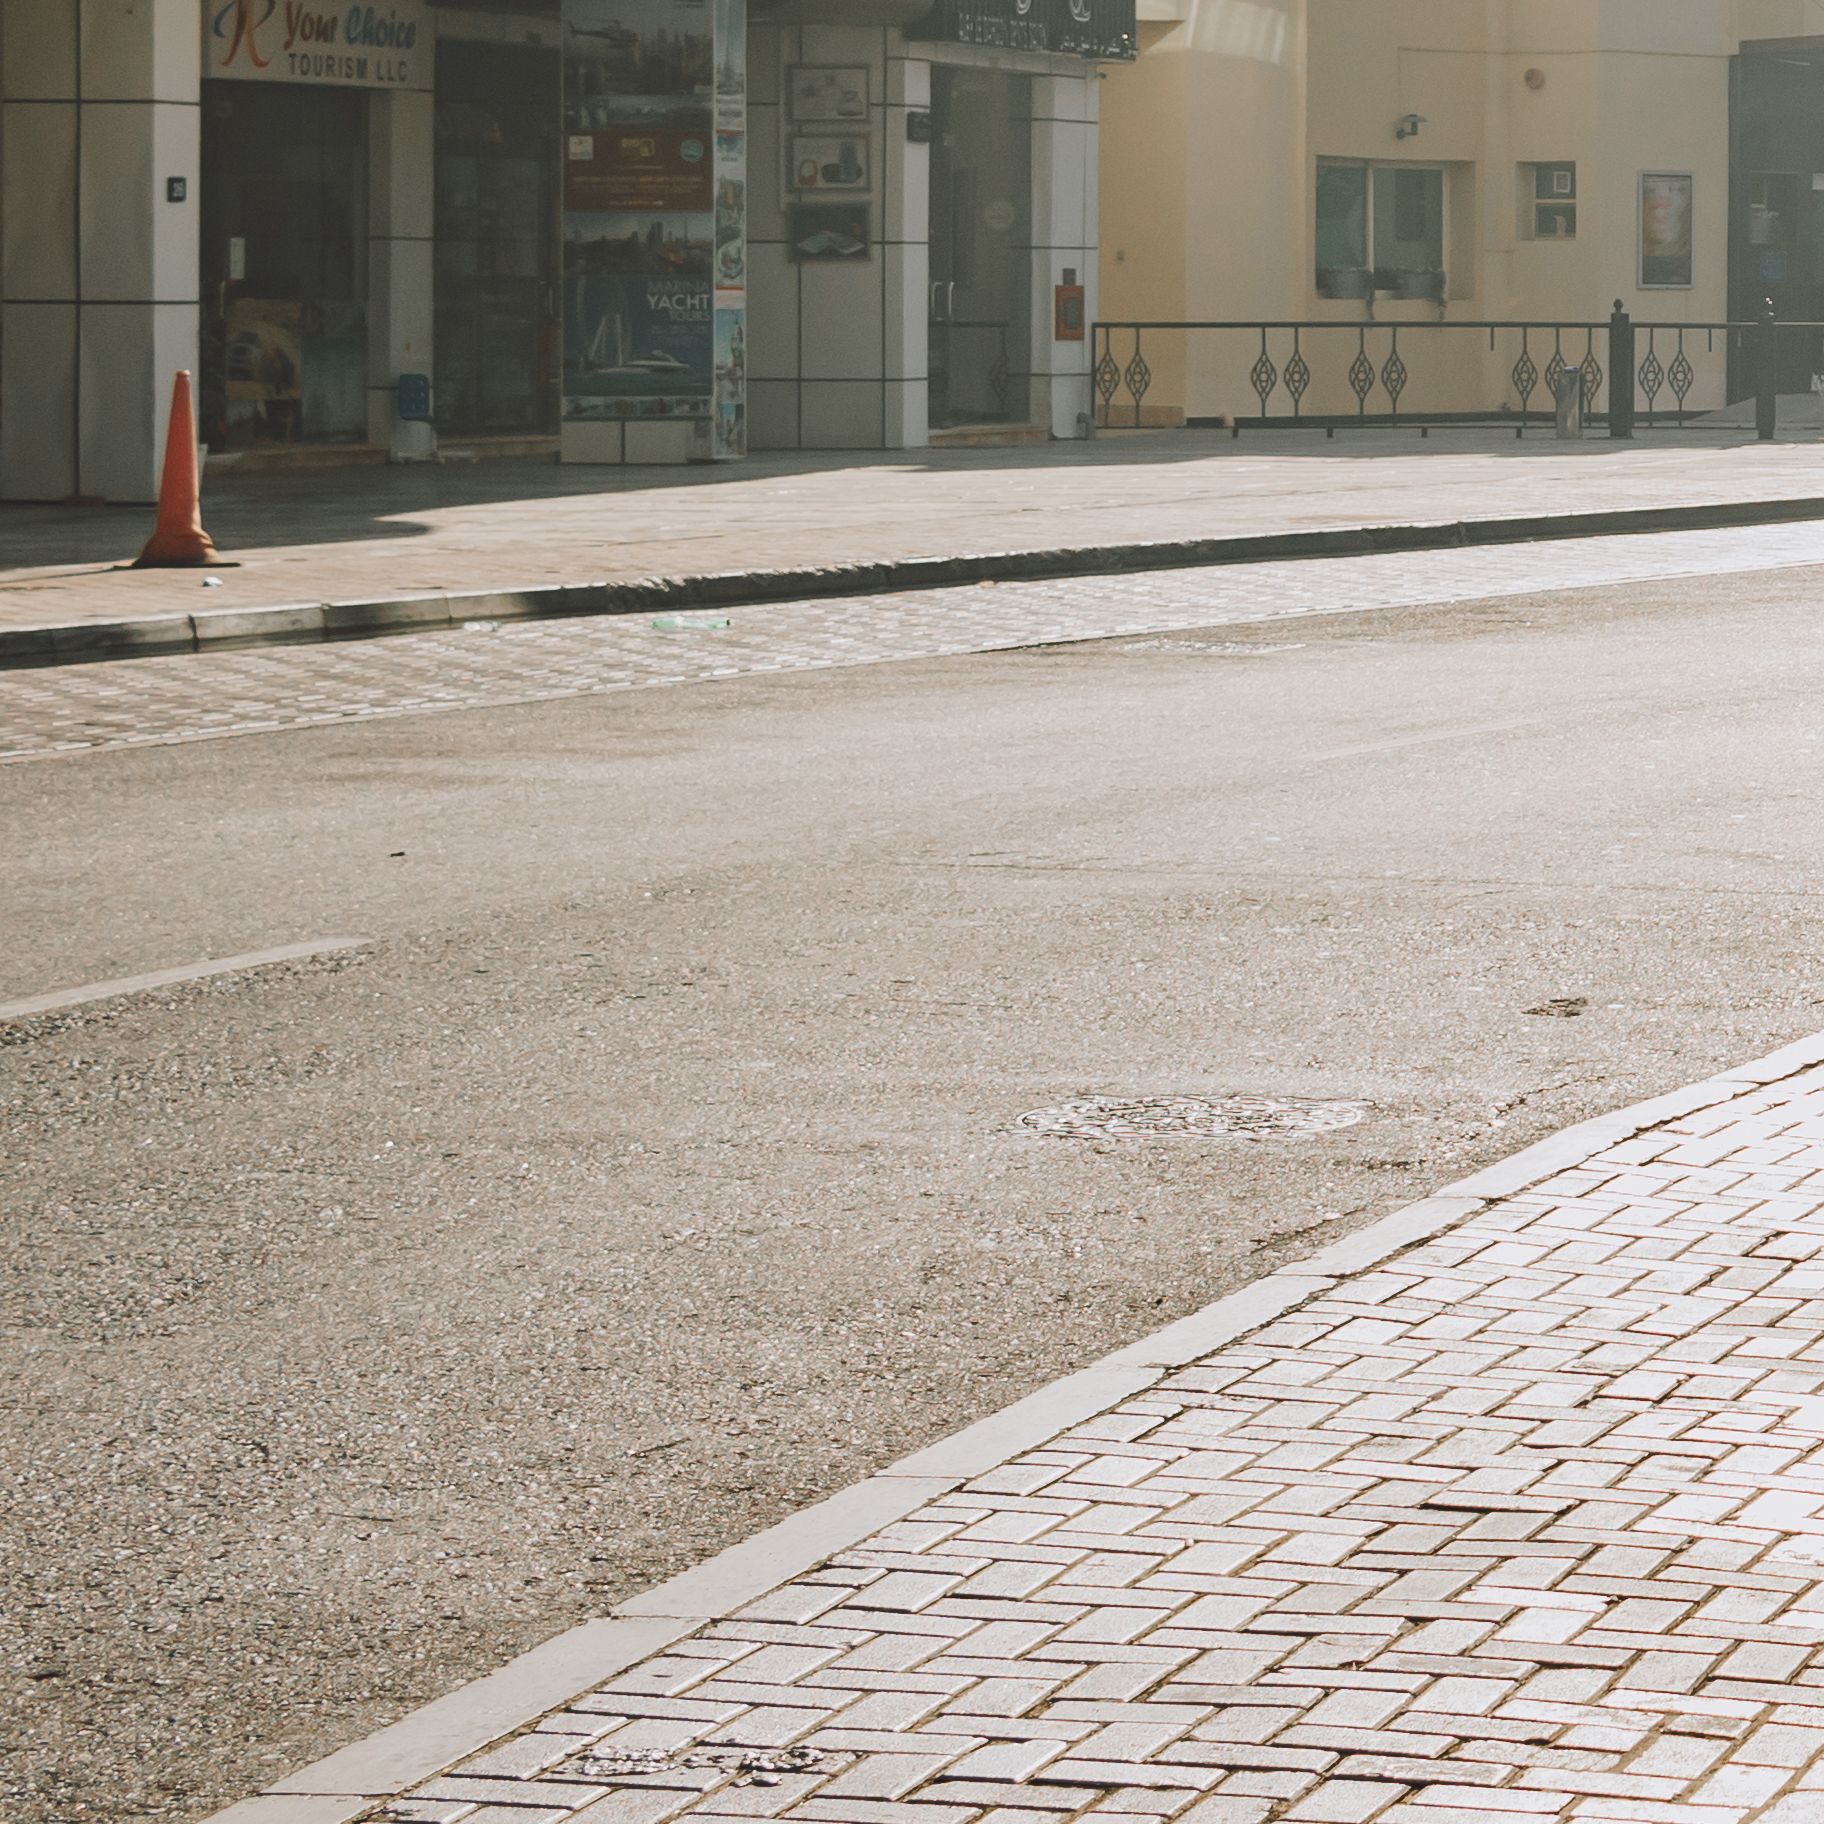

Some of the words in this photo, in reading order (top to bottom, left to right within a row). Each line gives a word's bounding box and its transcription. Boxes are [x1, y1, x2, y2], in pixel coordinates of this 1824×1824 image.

[284, 0, 337, 50] Your
[344, 5, 417, 49] Choice
[288, 53, 368, 80] TOURISM
[376, 59, 408, 82] LLC
[647, 293, 712, 310] YACHT
